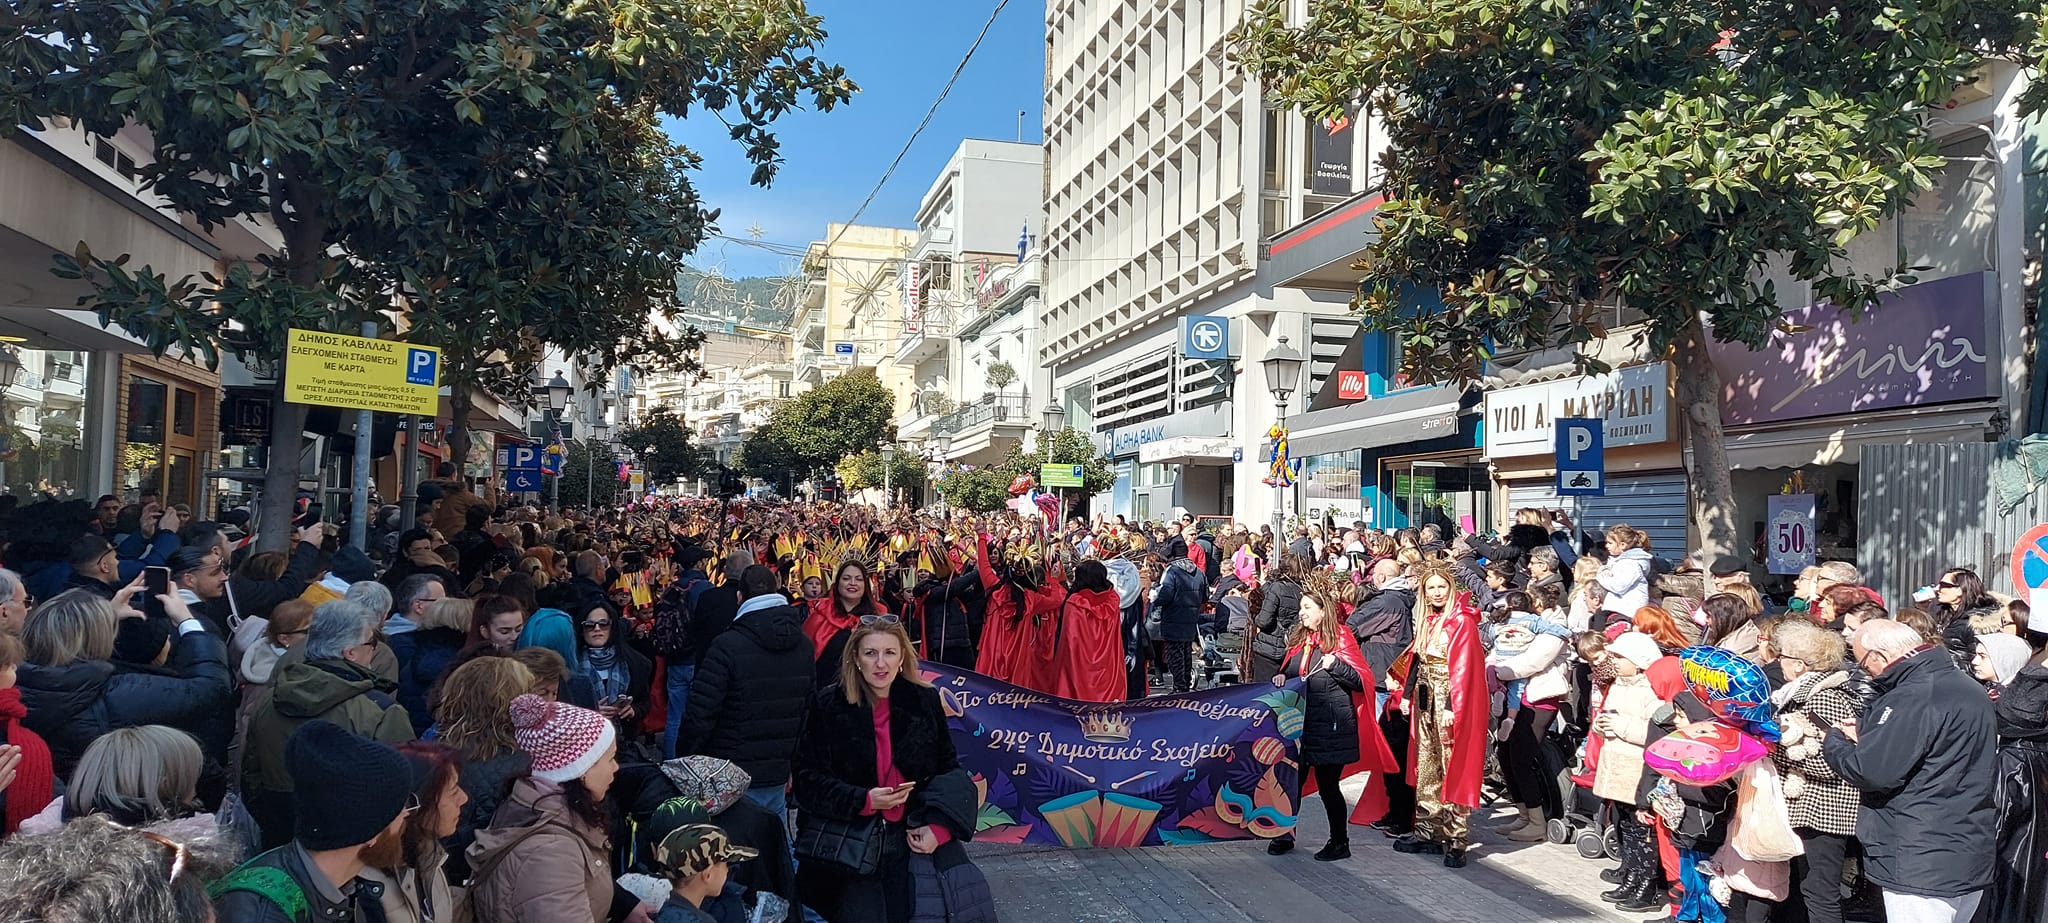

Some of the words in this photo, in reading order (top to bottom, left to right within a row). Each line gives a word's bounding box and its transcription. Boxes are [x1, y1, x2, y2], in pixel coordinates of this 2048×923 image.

[908, 266, 919, 331] Excellent
[298, 333, 339, 346] ΔΗΜΟΣ
[291, 345, 349, 360] ΕΛΕΓΧΟΜΕΝΗ
[350, 353, 398, 365] ΣΤΑΘΜΕΥΣΗ
[323, 362, 337, 370] ΜΕ
[338, 363, 366, 373] ΚΑΡΤΑ
[1340, 374, 1363, 395] illy
[327, 387, 360, 396] ΔΙΑΡΚΕΙΑ
[361, 390, 404, 401] ΣΤΑΘΜΕΥΣΗΣ
[410, 396, 429, 404] ΩΡΕΣ
[243, 404, 262, 426] LS
[1494, 404, 1526, 433] ΥΙΟΙ
[1563, 384, 1653, 421] ΜΑΥΡΙΔΗ
[1421, 416, 1453, 430] stretto
[1115, 430, 1139, 451] ALPHA
[1140, 424, 1165, 444] BANK
[1568, 426, 1593, 461] P
[515, 447, 534, 467] P
[954, 690, 985, 709] Το
[987, 688, 1054, 709] στέμμα
[1037, 730, 1148, 764] Δημοτικό
[1149, 735, 1236, 768] Σχολείο
